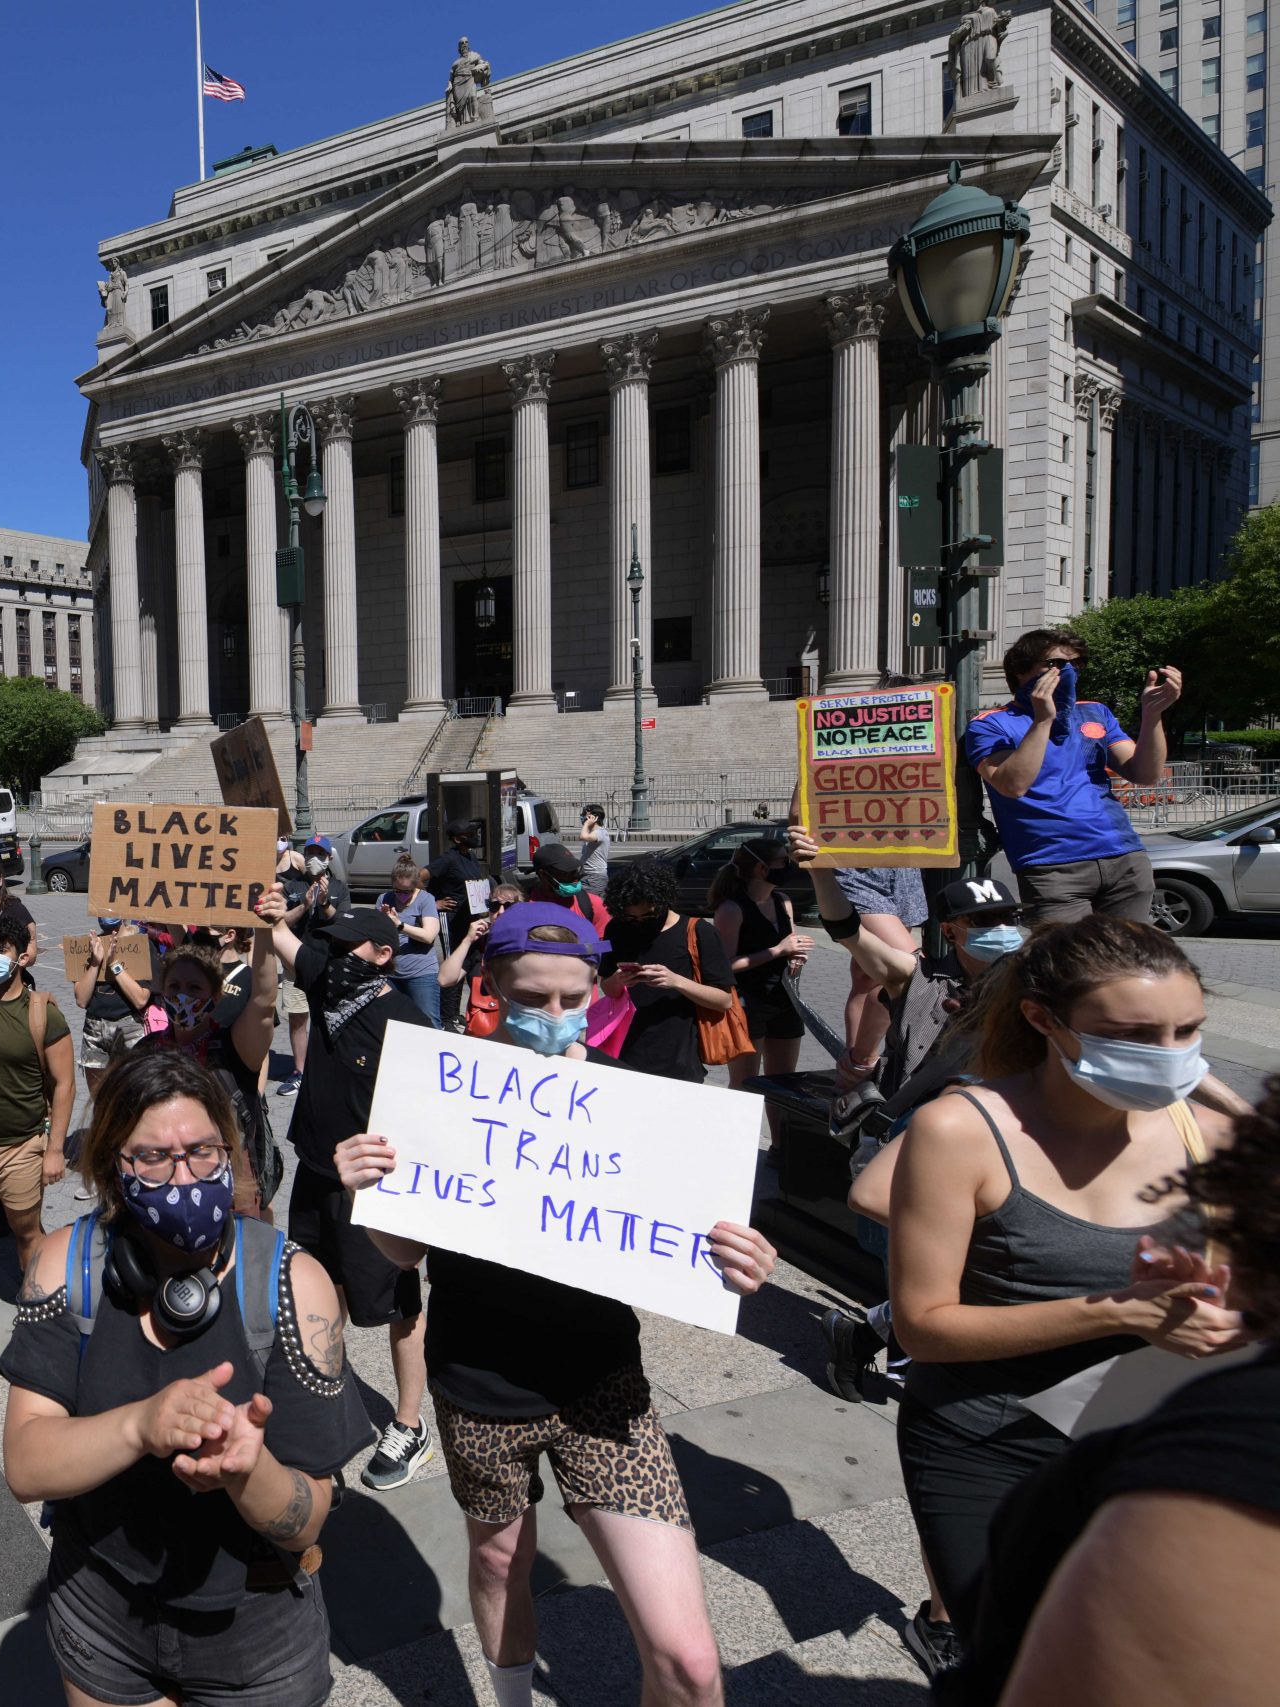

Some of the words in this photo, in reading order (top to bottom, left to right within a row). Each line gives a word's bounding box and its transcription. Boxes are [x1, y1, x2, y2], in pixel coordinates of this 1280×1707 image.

[322, 351, 345, 370] OF
[349, 333, 425, 364] JUSTICE
[433, 327, 449, 345] IS
[455, 317, 490, 339] THE
[498, 295, 585, 330] FIRMEST
[592, 278, 664, 309] PILLAR
[670, 269, 701, 291] OF
[712, 250, 785, 281] GOOD
[913, 588, 937, 606] RICKS
[816, 711, 845, 729] NO
[849, 704, 932, 726] JUSTICE
[820, 697, 859, 709] SERVE
[817, 730, 847, 746] NO
[850, 725, 927, 744] PEACE
[817, 748, 853, 757] BLACK
[858, 746, 886, 755] LIVES
[813, 762, 942, 791] GEORGE
[114, 809, 238, 836] BLACK
[819, 797, 940, 824] FLOYD
[125, 841, 239, 872] LIVES
[108, 876, 265, 911] MATTER
[965, 879, 1003, 903] M
[112, 940, 141, 955] ives
[439, 1051, 598, 1123] BLACK
[472, 1118, 621, 1180] TRANS
[376, 1162, 496, 1207] LIVES
[540, 1195, 726, 1283] MATTER
[173, 1283, 194, 1307] JBL
